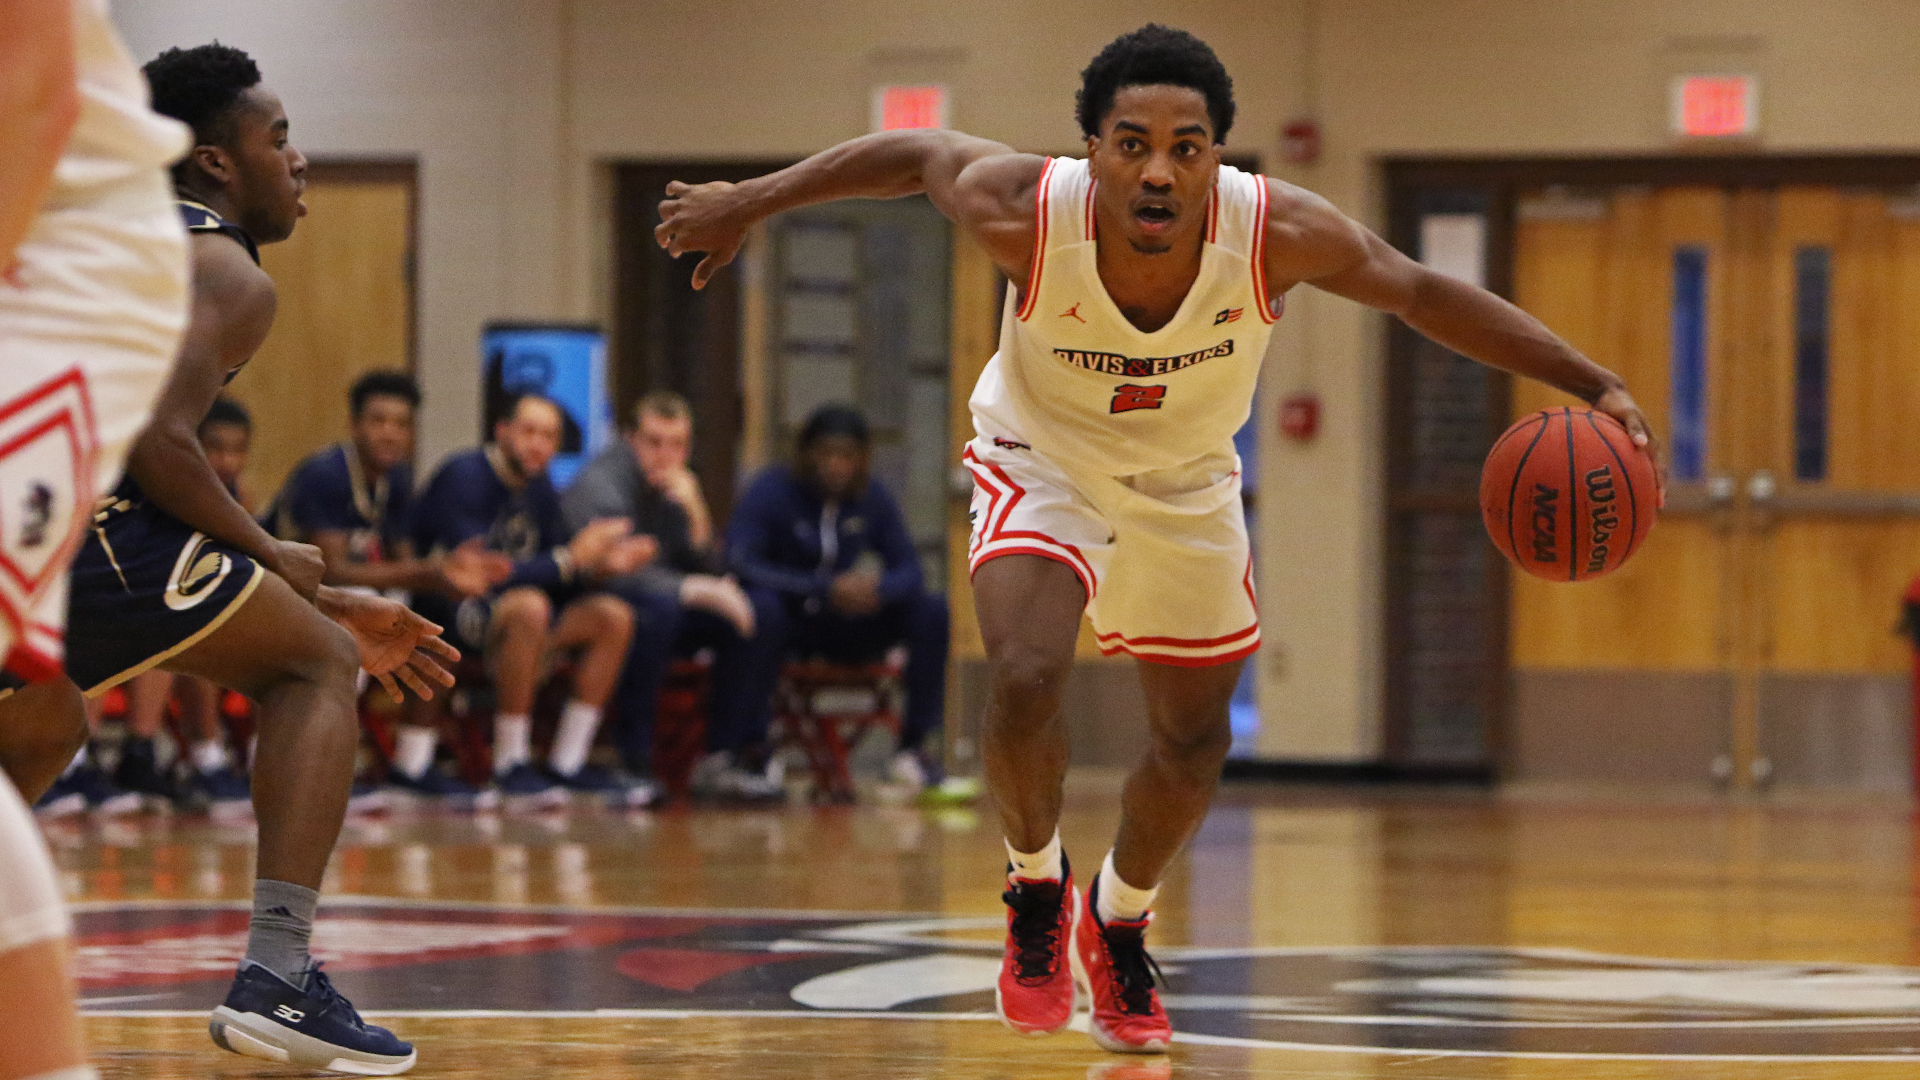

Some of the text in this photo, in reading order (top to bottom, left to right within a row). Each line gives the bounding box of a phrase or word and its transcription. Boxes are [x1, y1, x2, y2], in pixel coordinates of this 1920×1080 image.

[1110, 384, 1167, 414] 2
[1532, 483, 1558, 562] NCAA
[1585, 464, 1618, 573] Wilson
